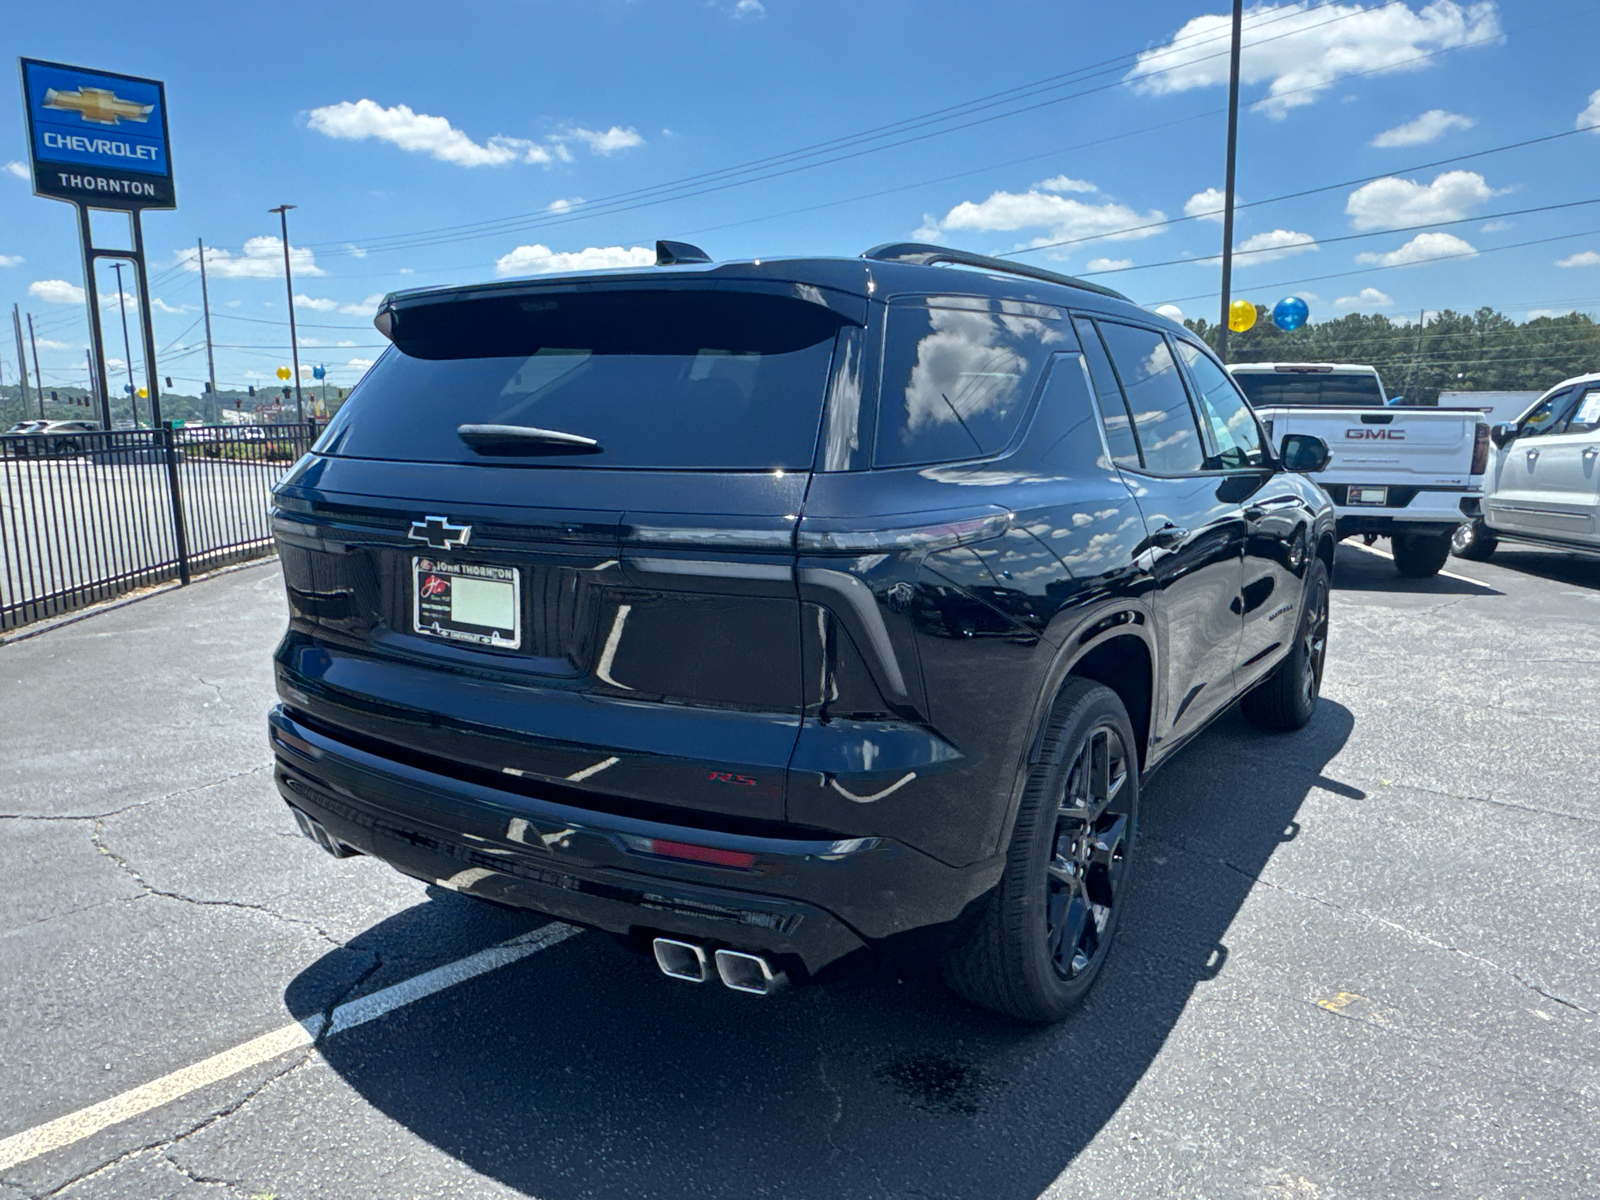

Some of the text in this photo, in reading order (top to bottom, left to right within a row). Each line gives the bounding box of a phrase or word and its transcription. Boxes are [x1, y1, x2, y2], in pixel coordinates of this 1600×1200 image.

[43, 132, 158, 160] CHEVROLET
[58, 173, 155, 196] THORNTON
[1346, 429, 1405, 440] GMC
[461, 564, 512, 580] THORNTON
[709, 771, 756, 786] RS
